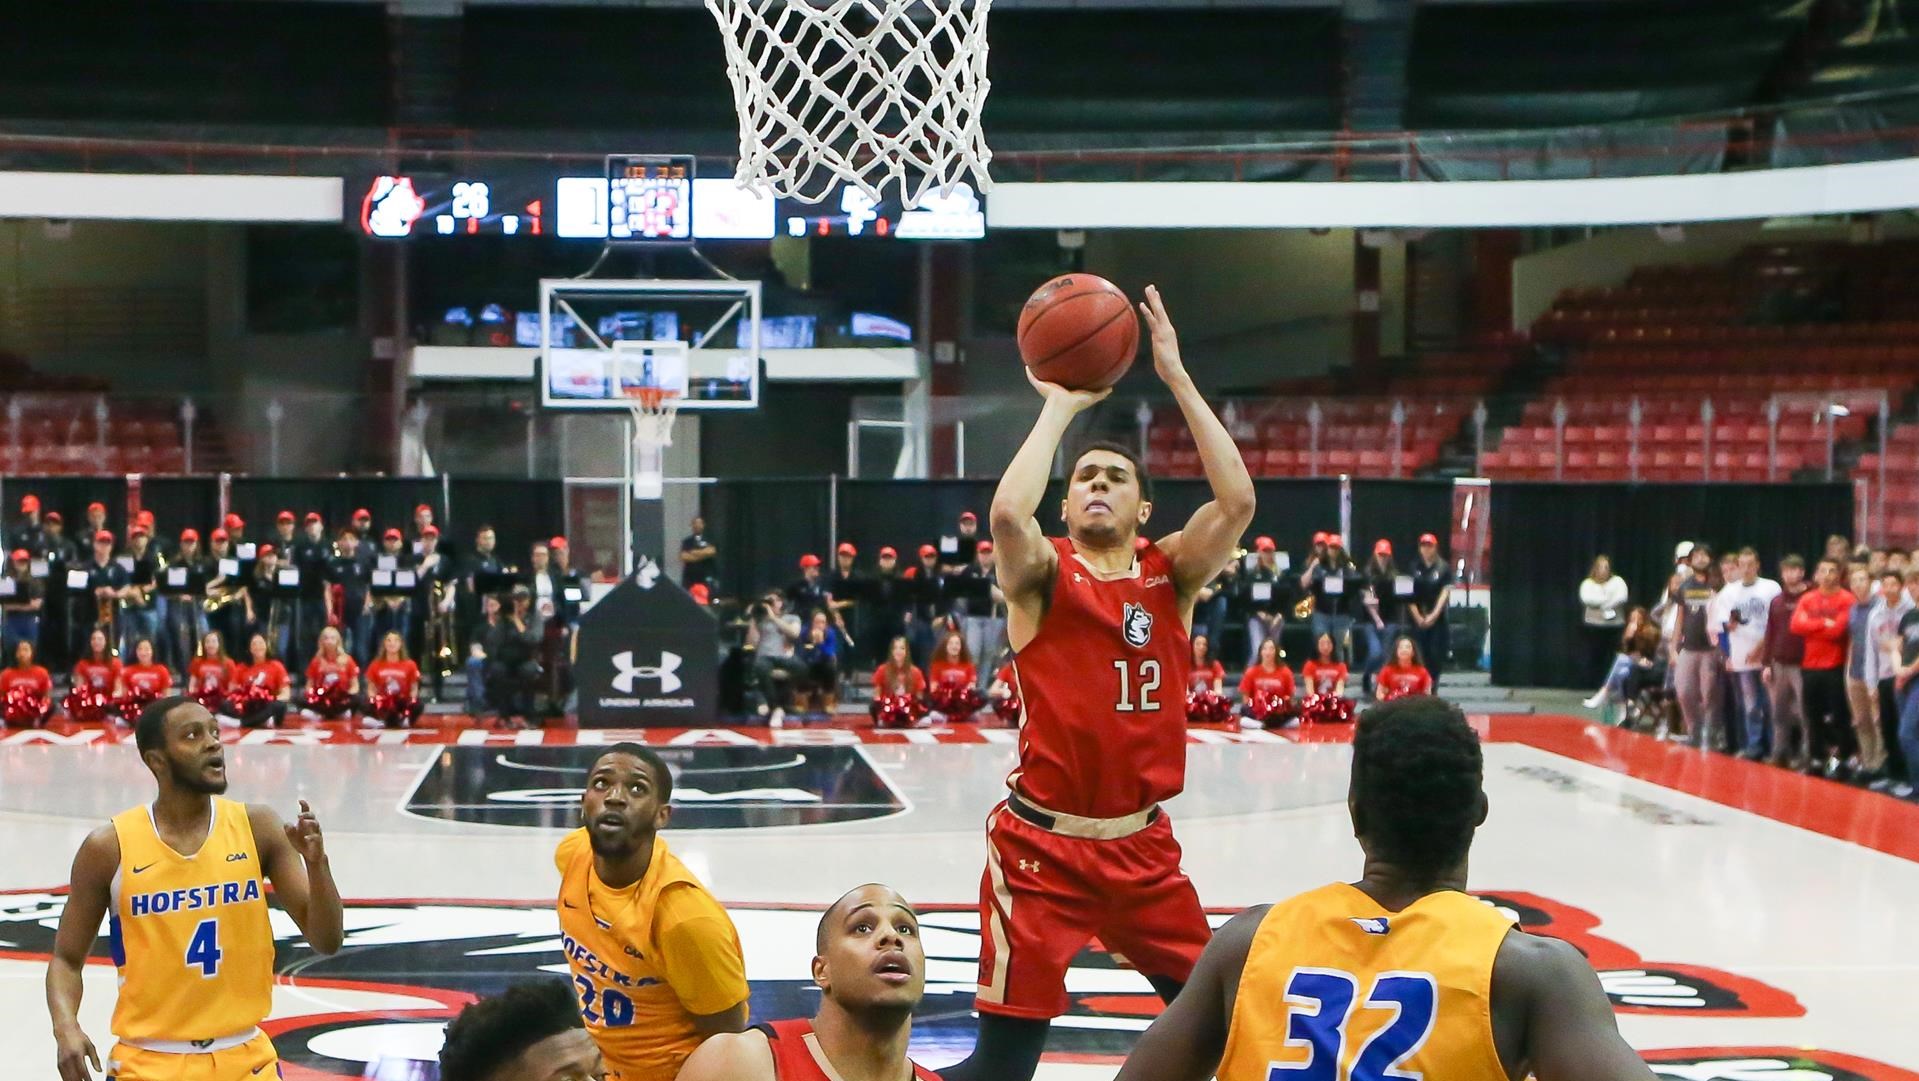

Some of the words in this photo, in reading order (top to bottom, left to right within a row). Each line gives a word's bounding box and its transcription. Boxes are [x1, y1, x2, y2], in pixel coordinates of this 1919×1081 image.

[1145, 574, 1169, 588] CAA
[1114, 659, 1161, 711] 12
[226, 852, 248, 862] CAA
[131, 879, 260, 917] HOFSTRA
[185, 919, 222, 978] 4
[574, 972, 636, 1028] 20
[1265, 967, 1438, 1081] 32
